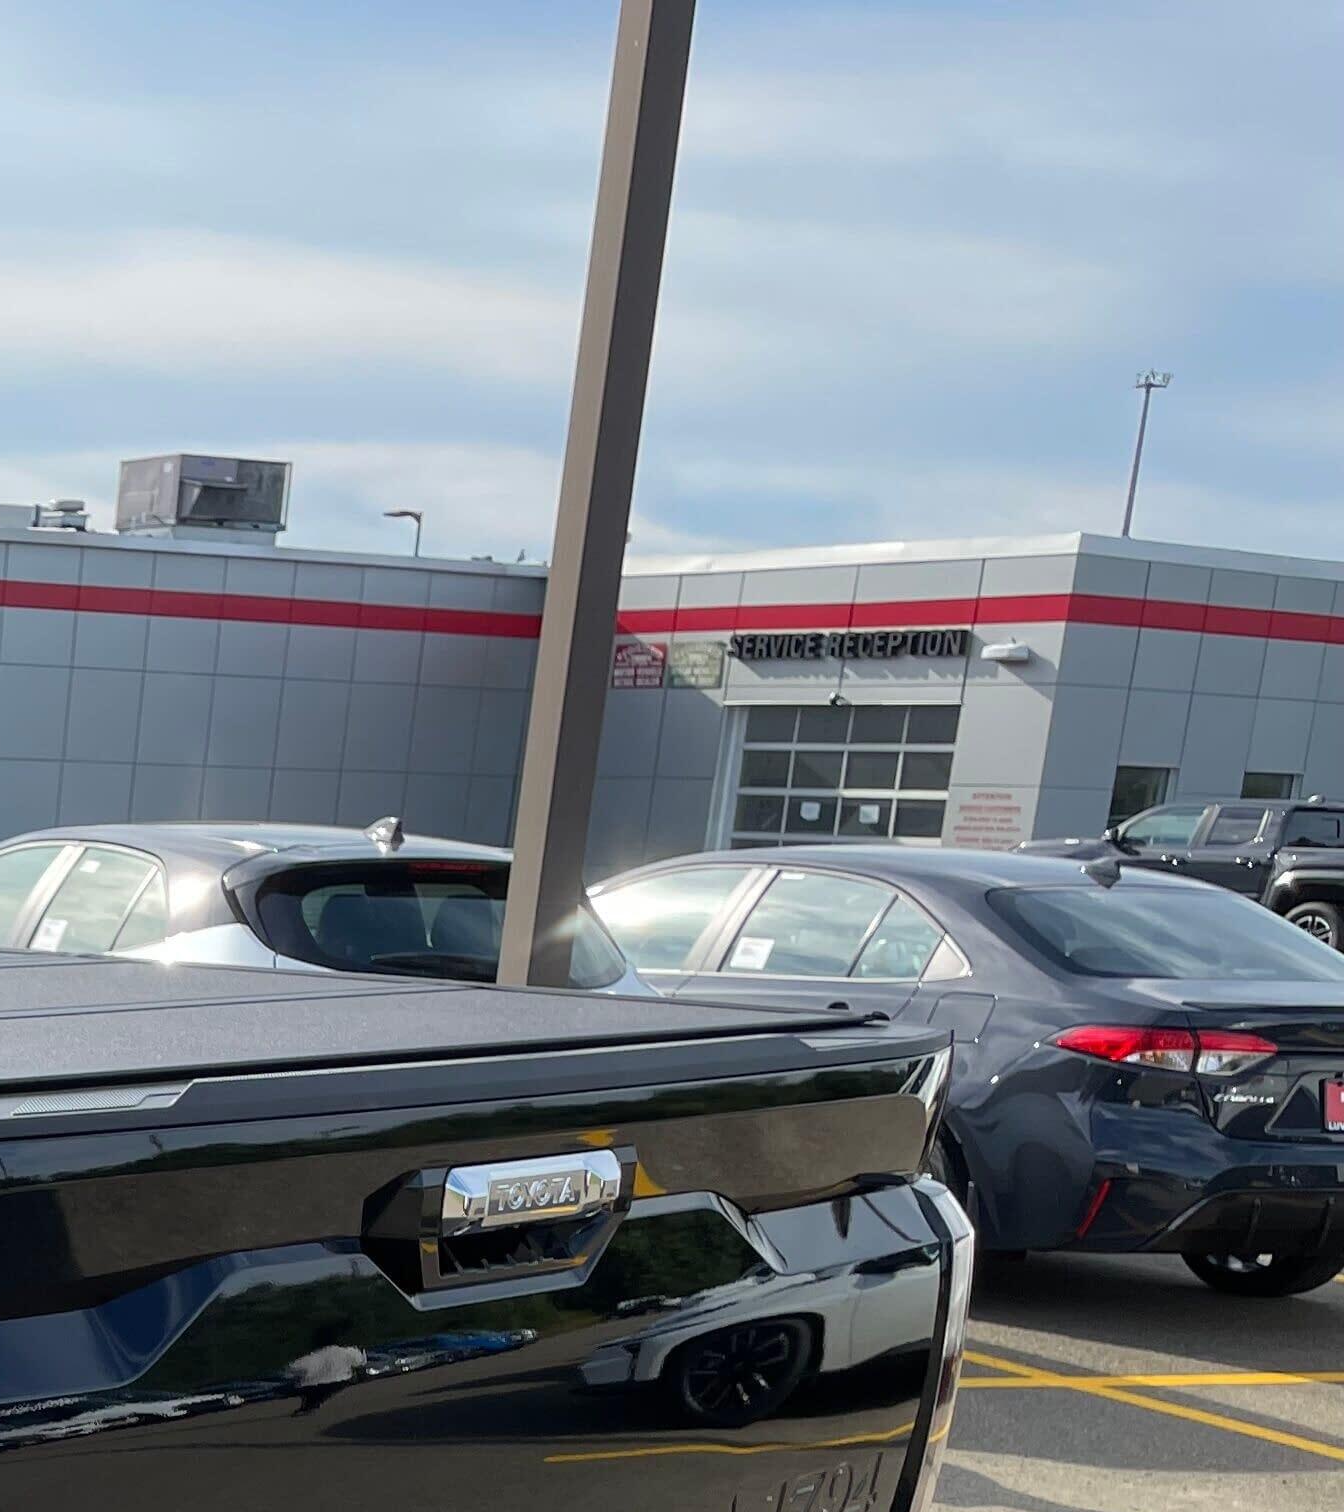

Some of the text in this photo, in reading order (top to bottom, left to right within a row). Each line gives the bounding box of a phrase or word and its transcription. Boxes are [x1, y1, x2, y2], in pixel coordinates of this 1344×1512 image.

[730, 630, 968, 658] SERVICE RECEPTION
[496, 1176, 576, 1212] TOYOTA
